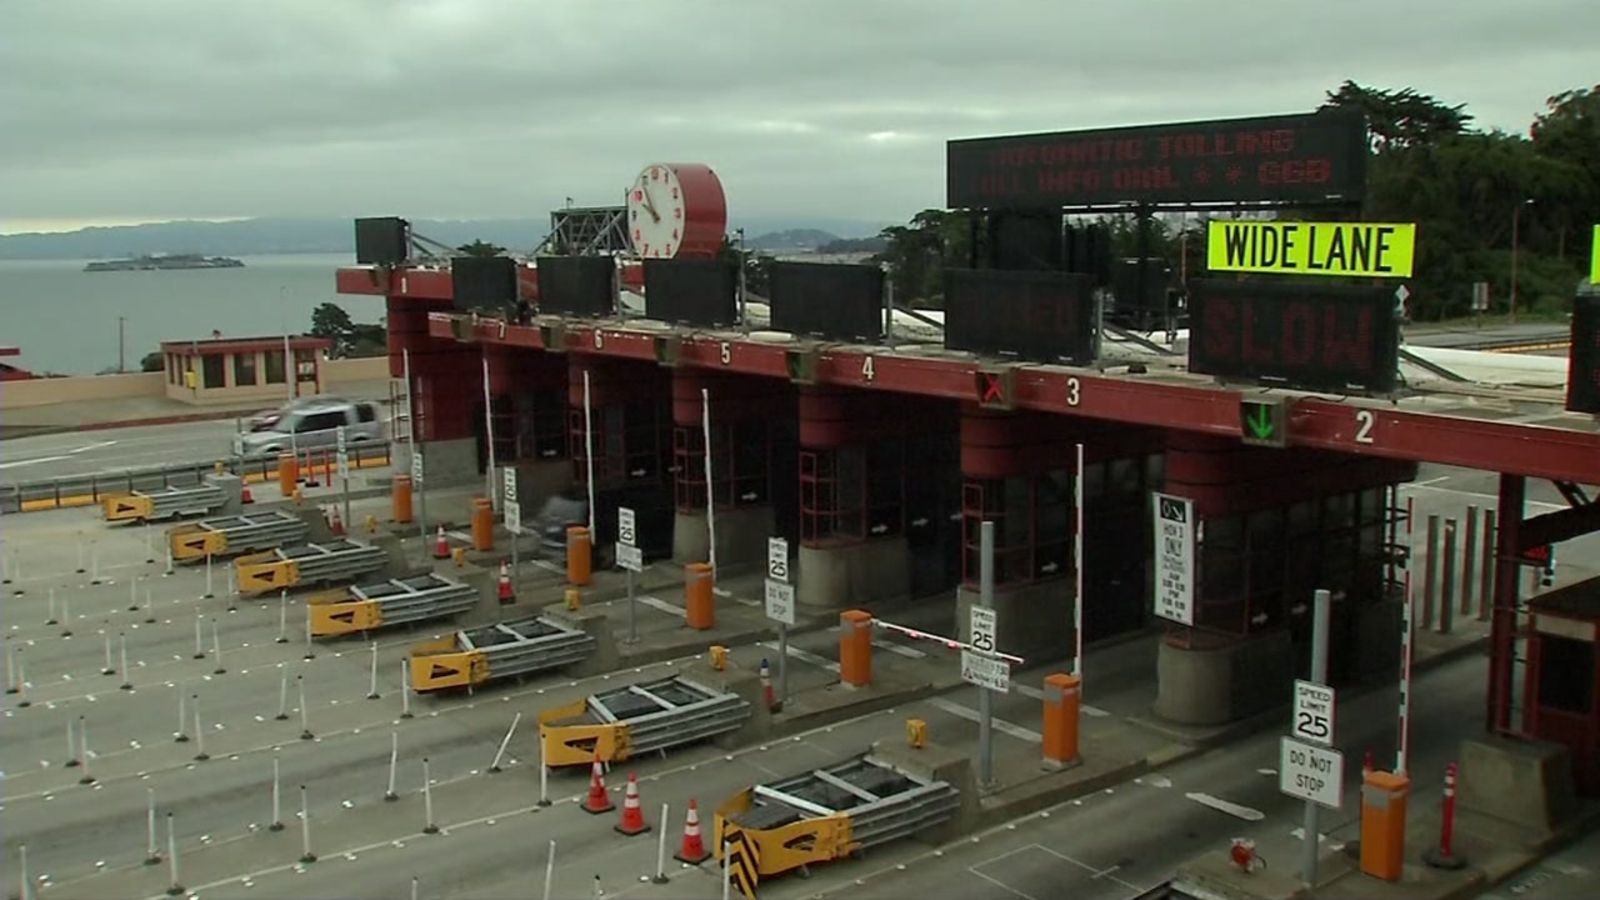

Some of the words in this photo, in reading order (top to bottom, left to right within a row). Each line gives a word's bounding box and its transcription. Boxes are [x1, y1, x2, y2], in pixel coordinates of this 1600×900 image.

[1156, 128, 1296, 157] TOLLING
[1257, 158, 1332, 184] GGB
[1225, 225, 1298, 269] WIDE
[1307, 225, 1395, 273] LANE
[498, 321, 505, 338] 7
[594, 329, 602, 348] 6
[1202, 297, 1375, 370] SLOW
[721, 342, 730, 363] 5
[862, 356, 875, 379] 4
[1067, 377, 1080, 405] 3
[1356, 411, 1374, 443] 2
[771, 560, 786, 577] 25
[973, 610, 993, 622] SPEED
[973, 619, 991, 629] LIMIT
[973, 630, 993, 651] 25
[1298, 686, 1331, 702] SPEED
[1300, 699, 1326, 714] LIMIT
[1298, 711, 1329, 737] 25
[1290, 749, 1306, 766] DO
[1309, 755, 1333, 773] NOT
[1296, 773, 1325, 791] STOP
